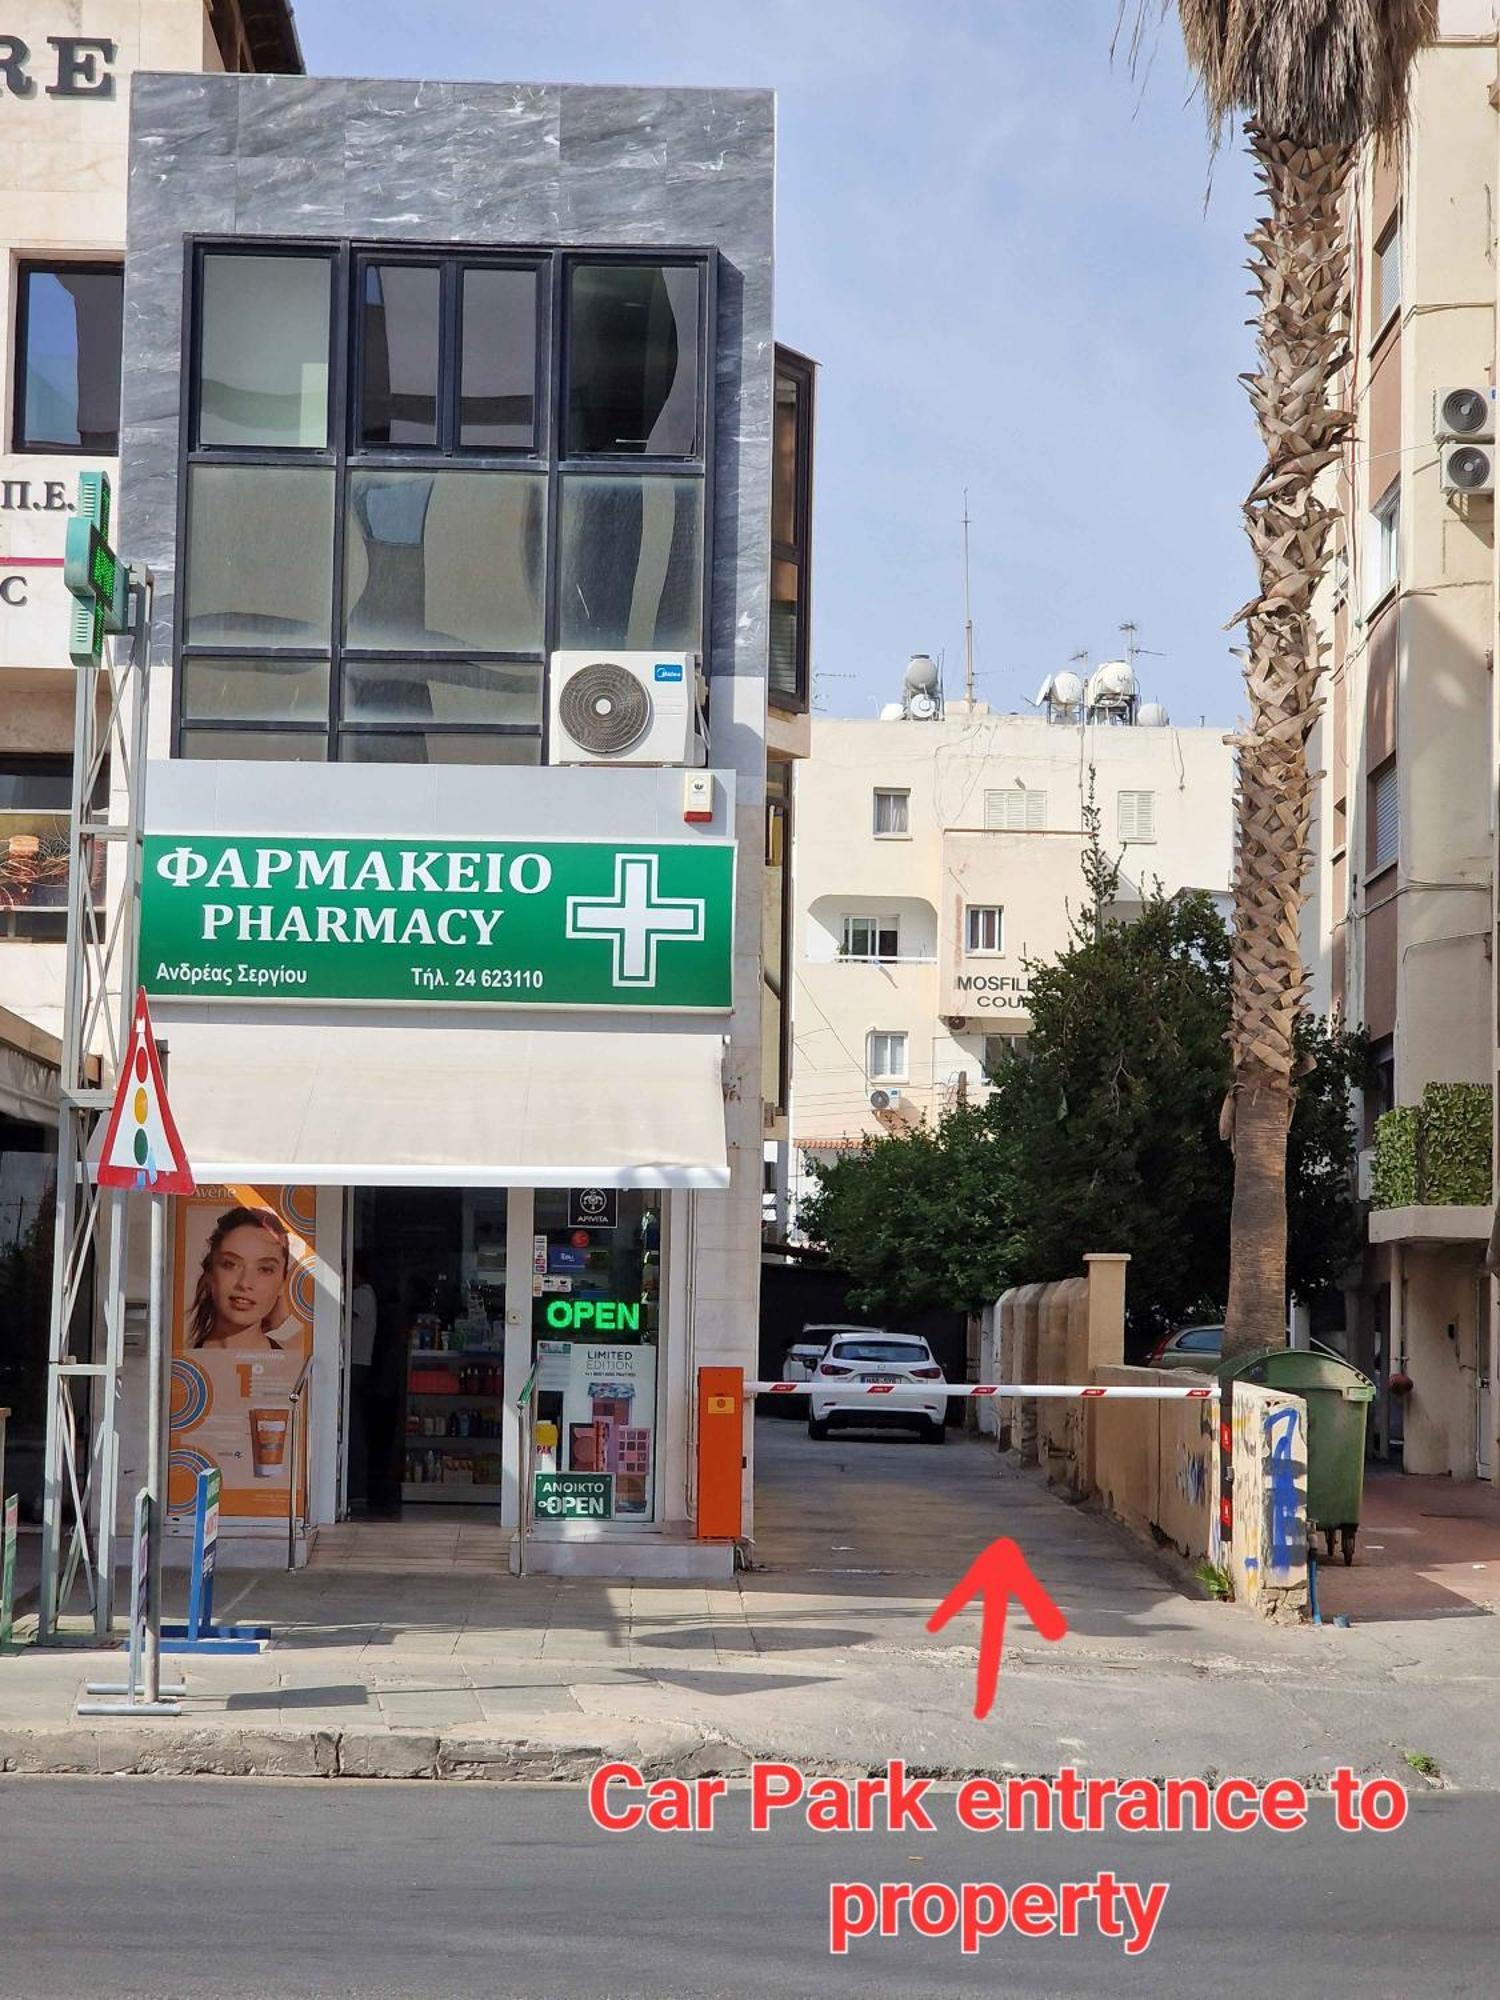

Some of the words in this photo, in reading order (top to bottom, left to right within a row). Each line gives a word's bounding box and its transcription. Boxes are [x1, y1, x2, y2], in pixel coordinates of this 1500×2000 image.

[656, 667, 681, 678] Midea
[156, 847, 553, 894] ΦΑΡΜΑΚΕΙΟ
[201, 904, 505, 946] PHARMACY
[156, 962, 233, 985] Ανδρέας
[237, 964, 307, 987] Σεργίου
[411, 967, 449, 990] Τήλ.
[455, 969, 476, 987] 24
[481, 970, 544, 988] 623110
[957, 976, 1031, 992] MOSFIL
[546, 1300, 640, 1330] OPEN
[587, 1351, 633, 1361] LIMITED
[586, 1360, 633, 1370] EDITION
[542, 1482, 605, 1493] ΑΝΟΙΚΤΟ
[547, 1497, 604, 1514] OPEN
